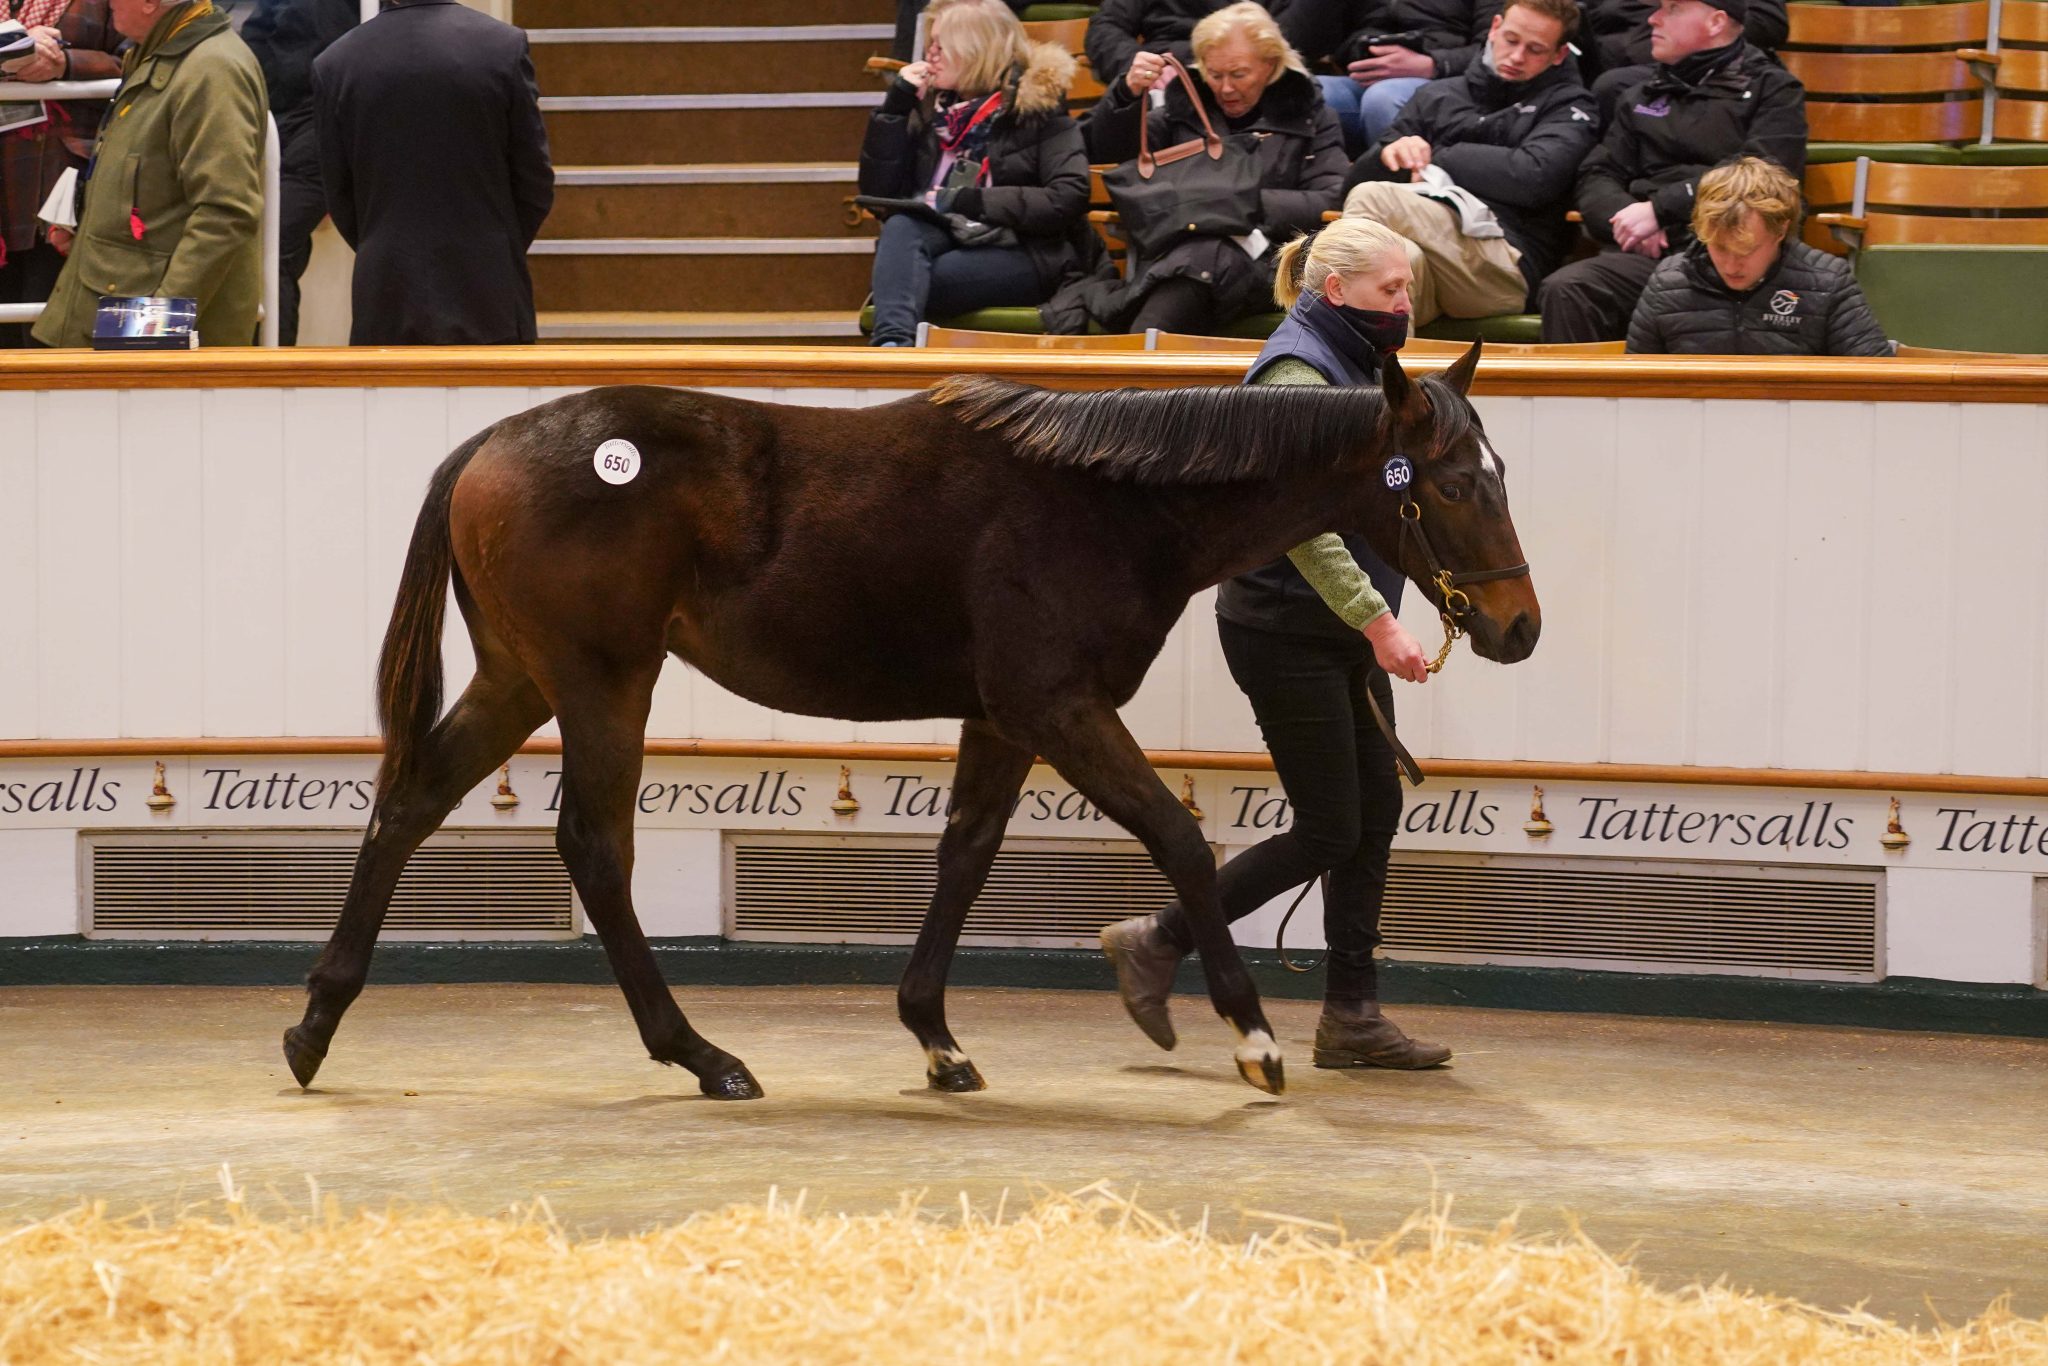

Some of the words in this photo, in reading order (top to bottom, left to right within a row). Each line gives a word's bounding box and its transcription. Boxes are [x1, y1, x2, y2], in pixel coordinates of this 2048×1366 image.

[604, 454, 630, 473] 650
[1386, 465, 1410, 487] 650
[0, 767, 120, 813] salls
[203, 768, 462, 811] Tatters
[543, 770, 806, 816] Tersalls
[1230, 786, 1499, 835] Taalls
[1578, 797, 1854, 849] Tattersalls
